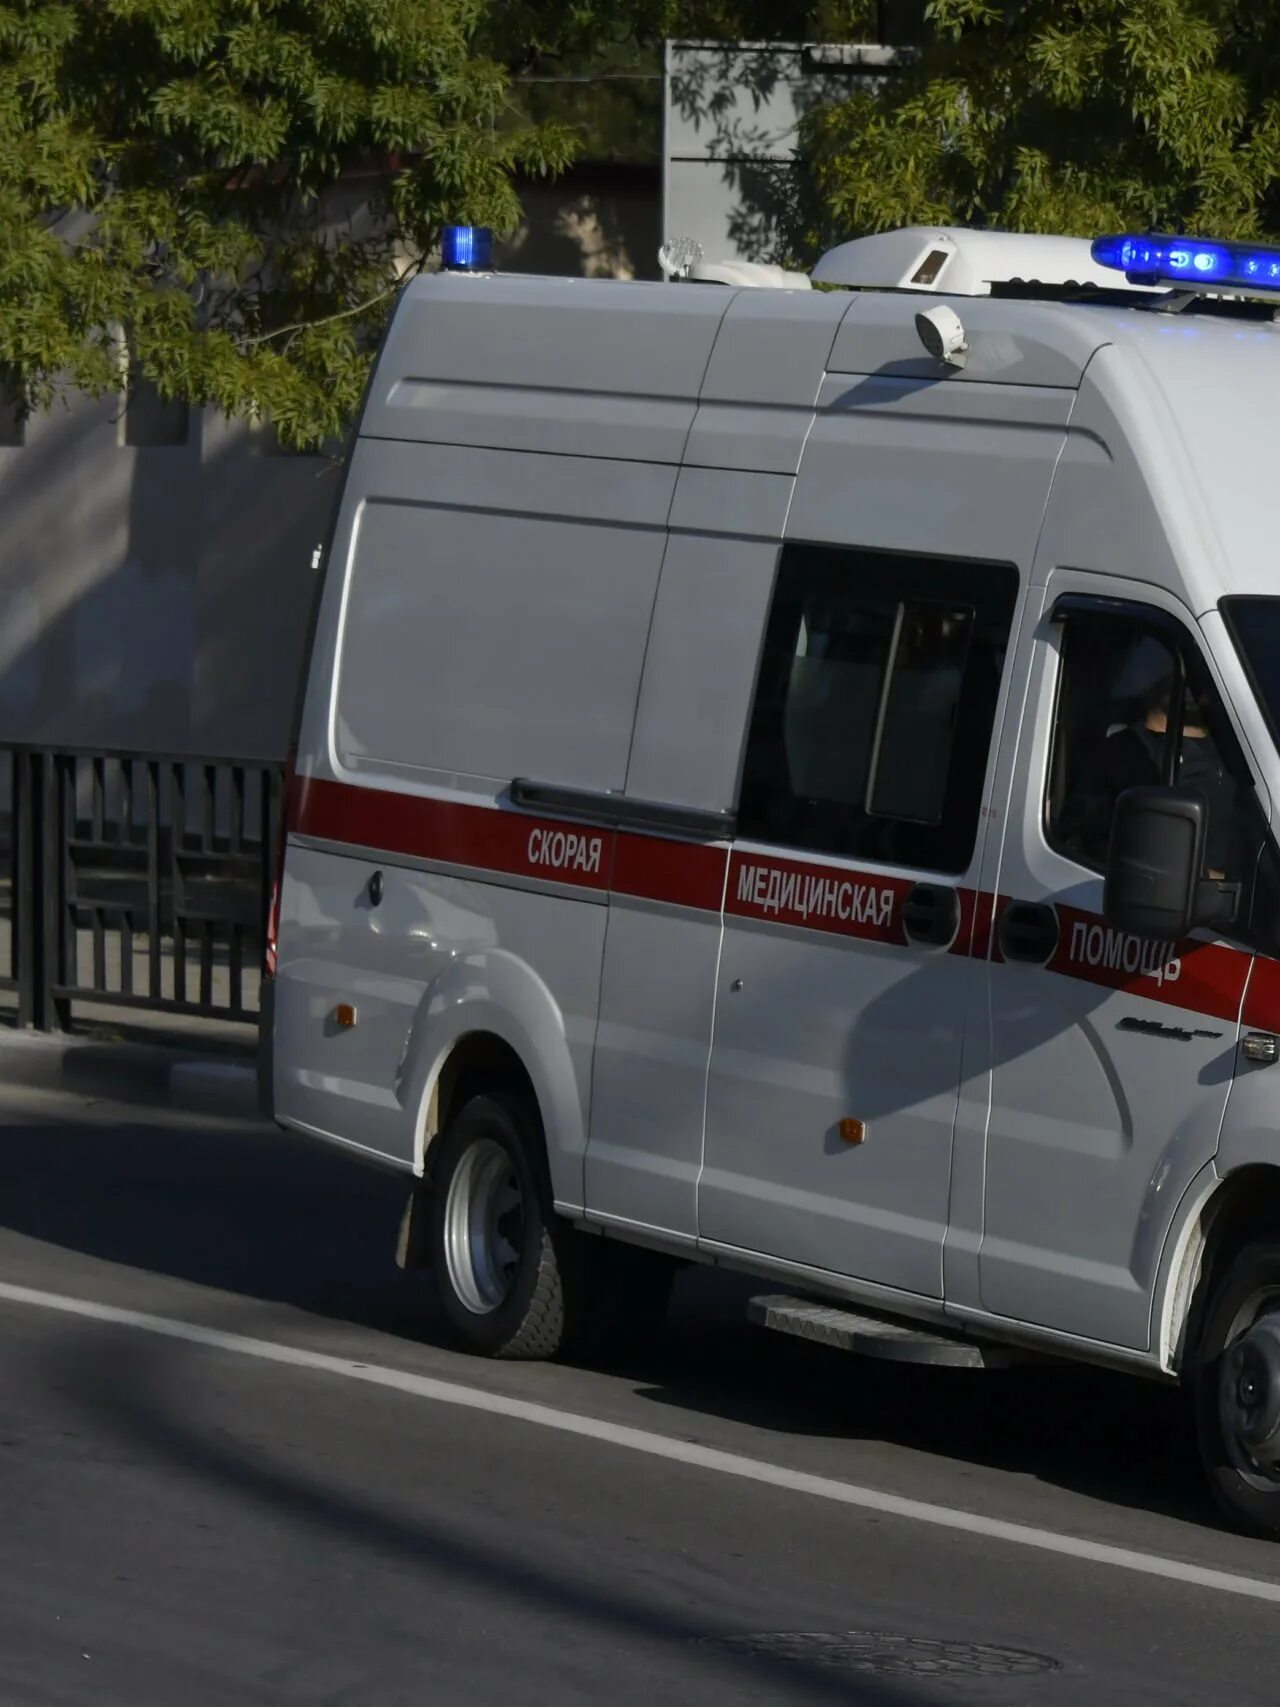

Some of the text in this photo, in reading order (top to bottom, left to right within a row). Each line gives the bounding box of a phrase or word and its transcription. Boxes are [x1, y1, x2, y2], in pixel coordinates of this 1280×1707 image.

[527, 827, 1182, 988] СКОРАЯ МЕДИЦИНСКАЯ ПОМОЩЬ
